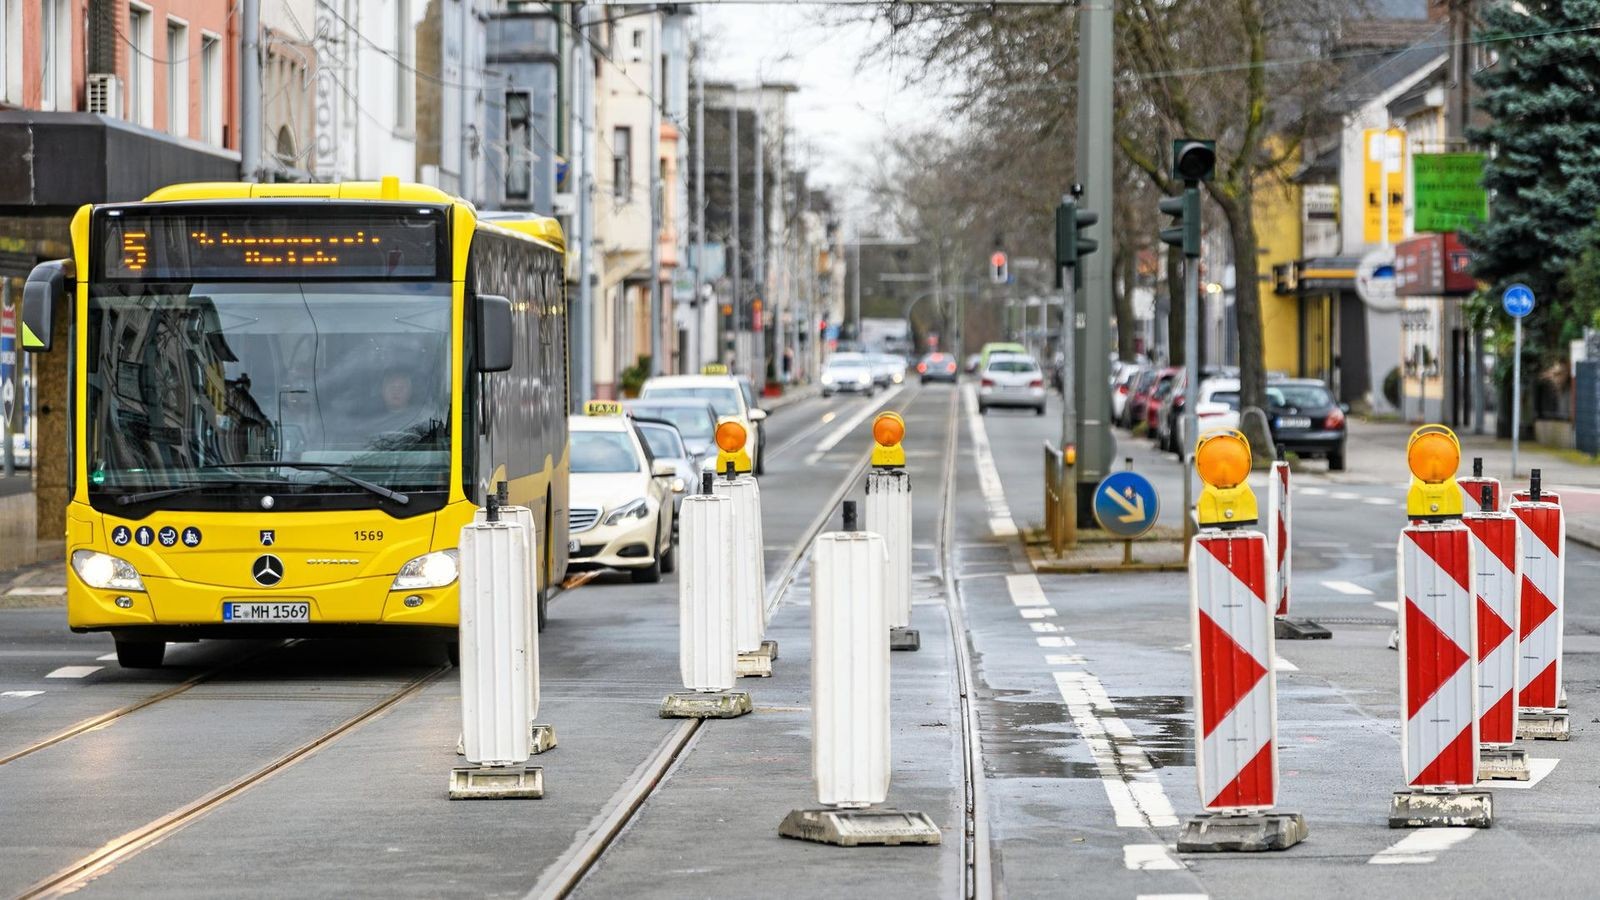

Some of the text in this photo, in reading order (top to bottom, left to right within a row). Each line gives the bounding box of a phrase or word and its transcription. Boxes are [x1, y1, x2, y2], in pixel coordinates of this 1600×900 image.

[589, 404, 618, 413] TAXI
[354, 530, 384, 541] 1569
[233, 605, 307, 618] E MH 1569
